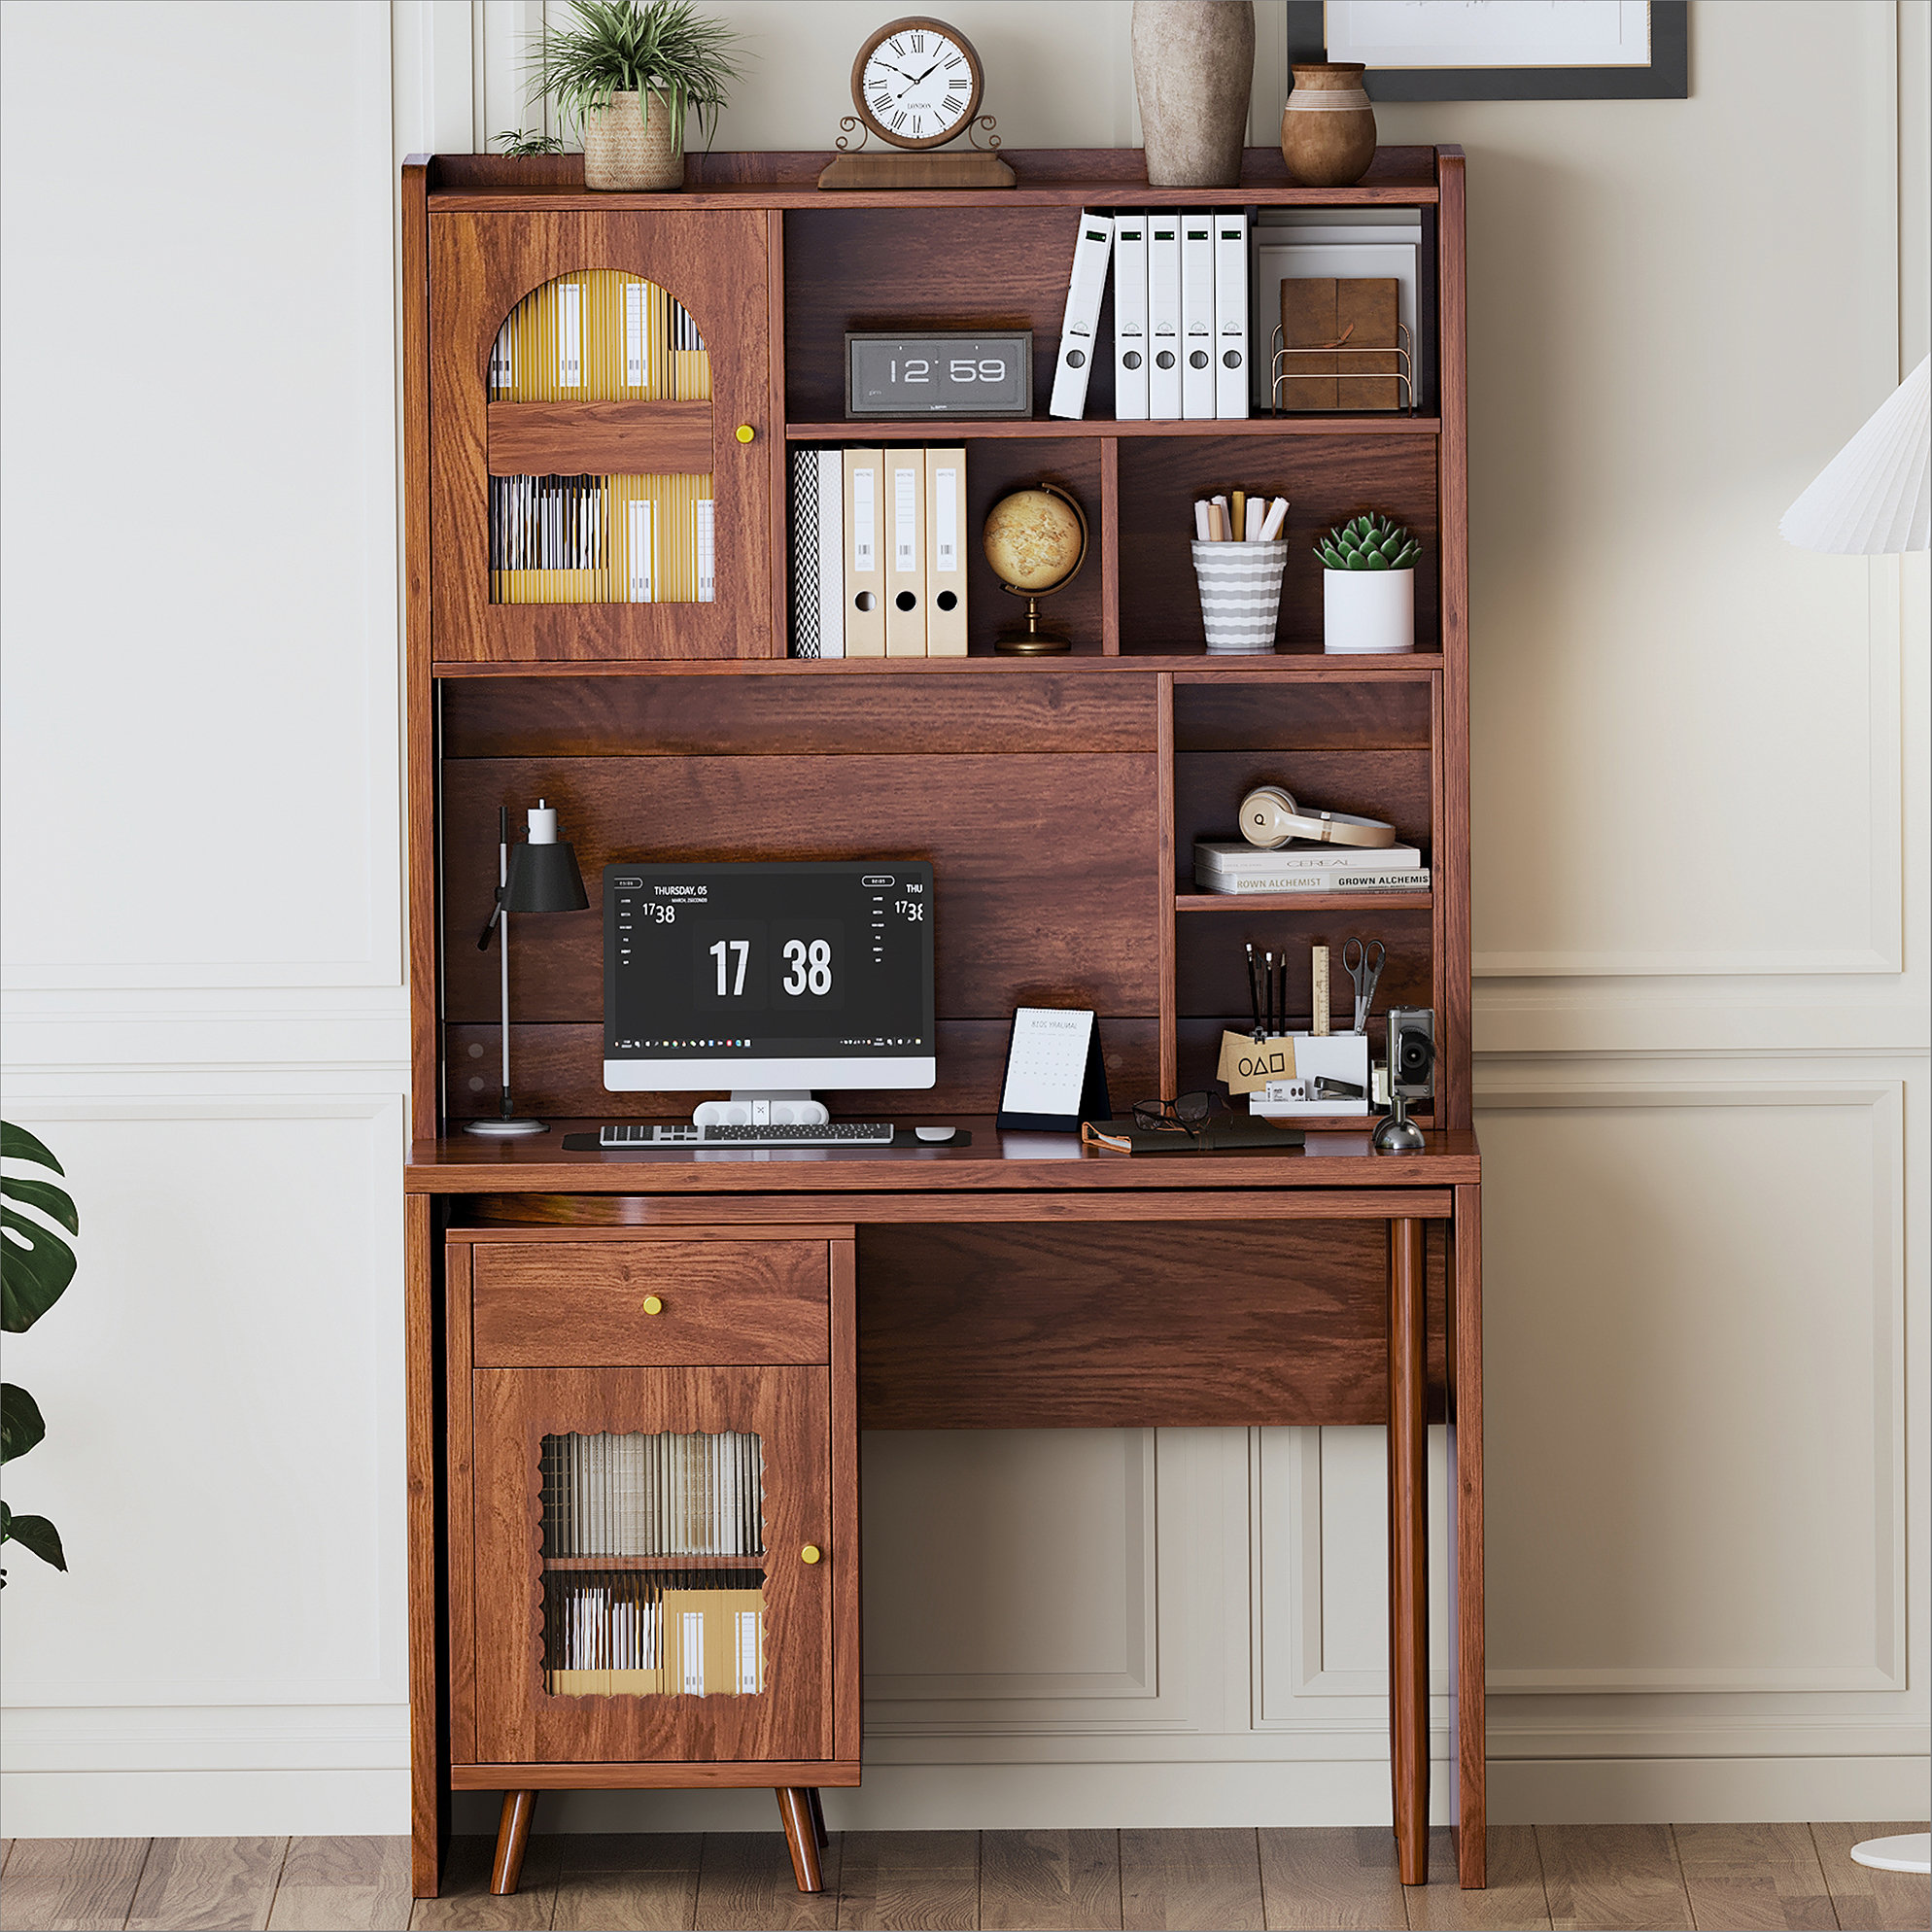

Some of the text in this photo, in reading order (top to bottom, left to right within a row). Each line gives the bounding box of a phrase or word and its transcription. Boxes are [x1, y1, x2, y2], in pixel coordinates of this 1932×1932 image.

[889, 39, 906, 59] XI
[911, 35, 923, 52] XII
[944, 56, 962, 70] II
[868, 79, 887, 89] IX
[949, 79, 967, 89] III
[873, 92, 894, 116] VIII
[887, 109, 908, 130] VII
[913, 115, 923, 133] VI
[1287, 859, 1354, 868] CEREAL
[1268, 878, 1322, 888] ALCHEMIST
[1338, 875, 1429, 886] GROWN ALCHEMIS
[654, 885, 707, 896] THURSDAY, 05
[906, 883, 923, 894] THU
[709, 939, 833, 996] 17 38
